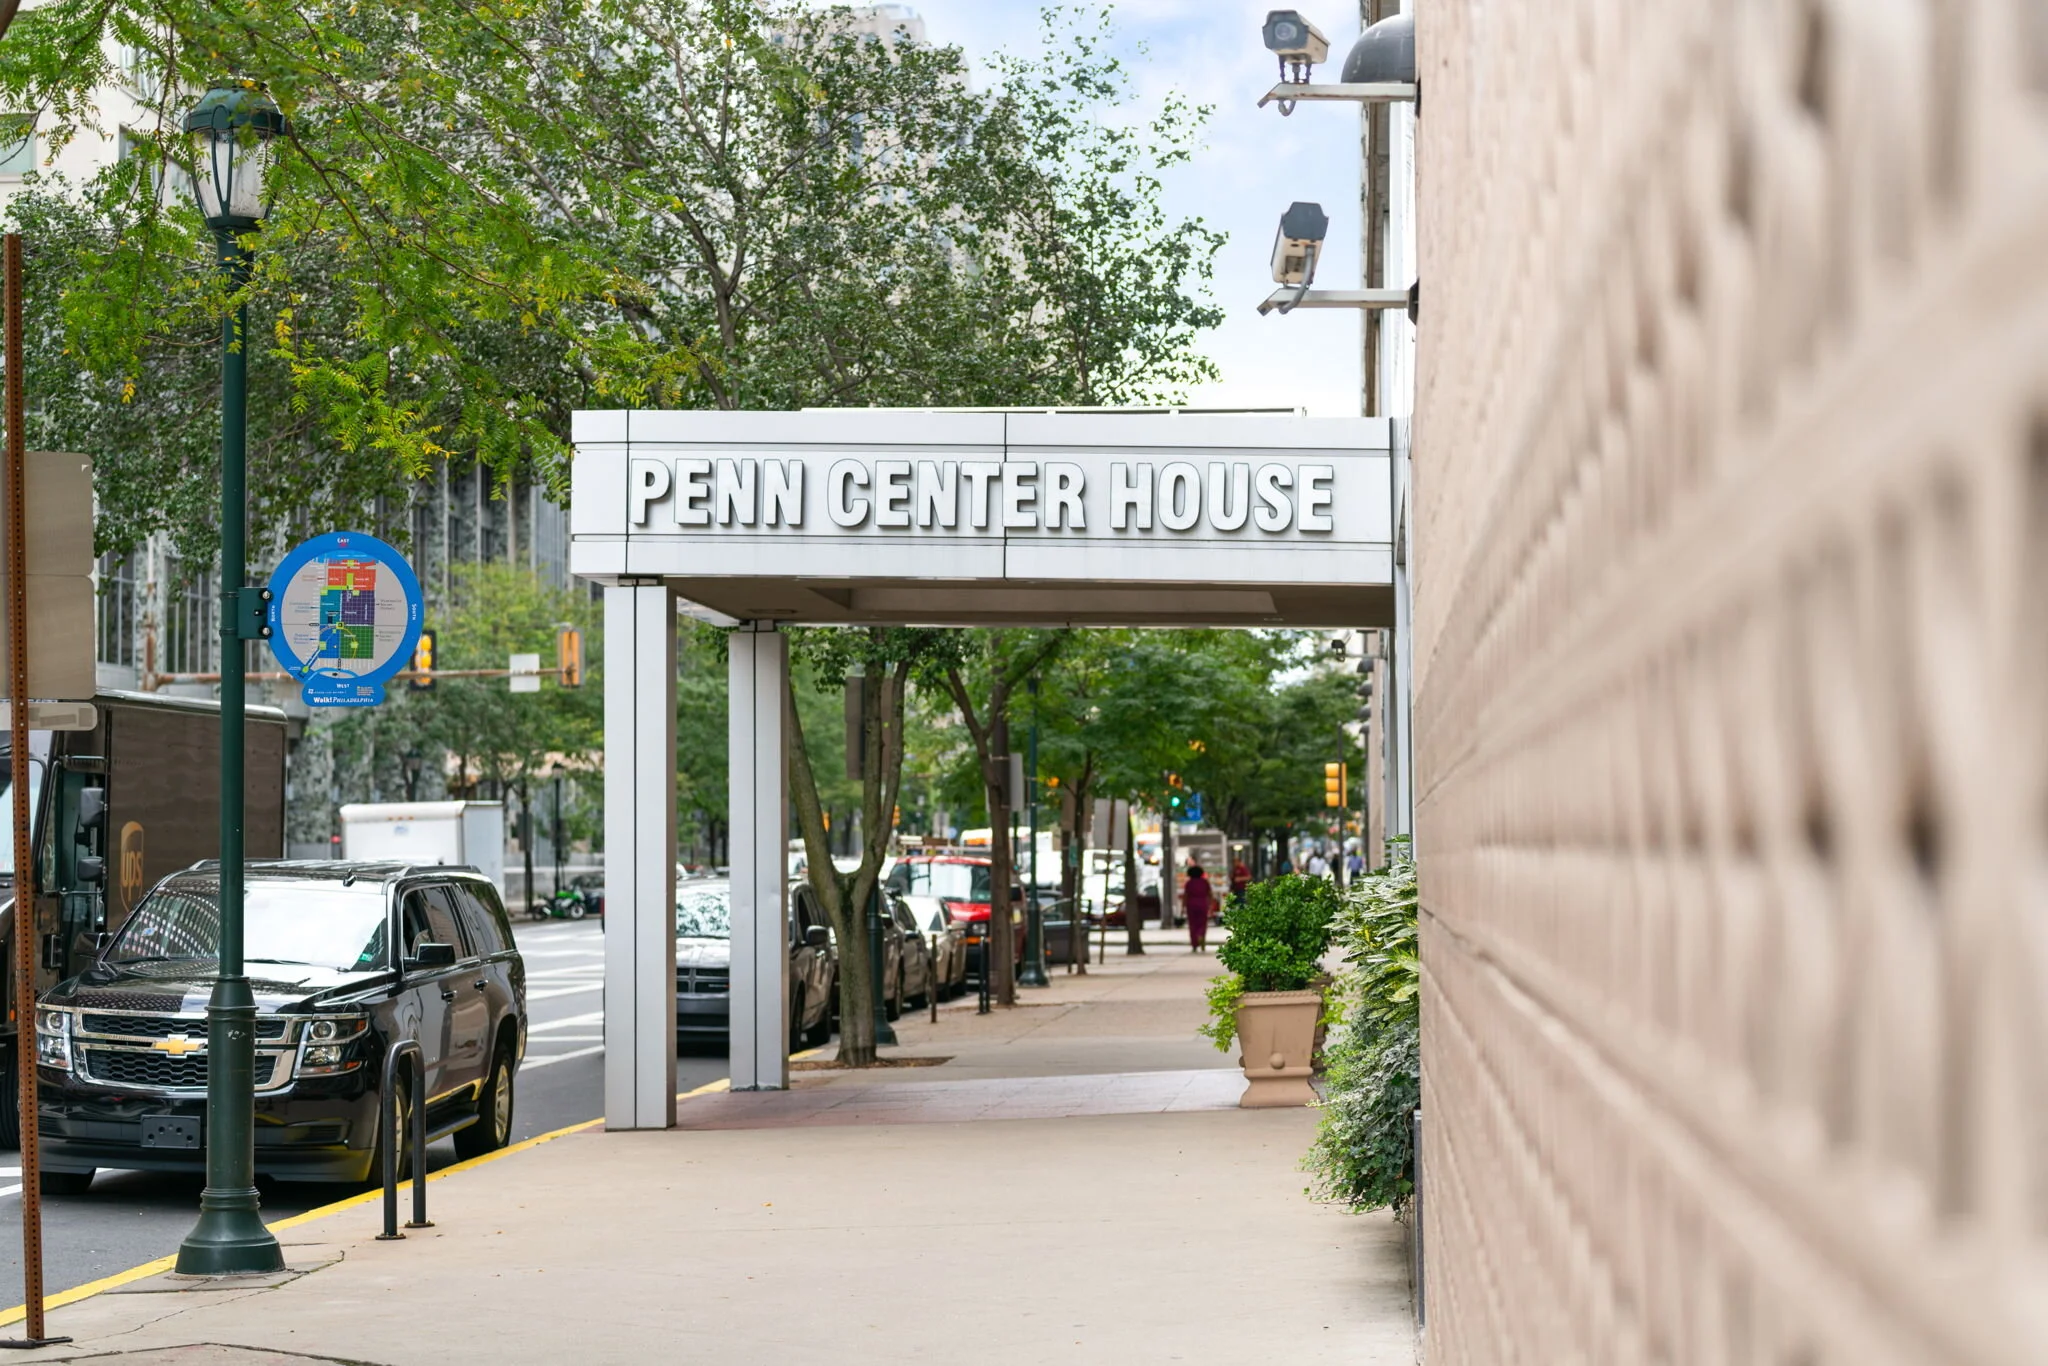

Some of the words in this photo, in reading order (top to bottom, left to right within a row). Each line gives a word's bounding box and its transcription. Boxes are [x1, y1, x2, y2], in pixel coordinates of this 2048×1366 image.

[629, 458, 804, 527] PENN
[827, 459, 1087, 529] CENTER
[1110, 462, 1335, 533] HOUSE
[122, 850, 143, 901] ups
